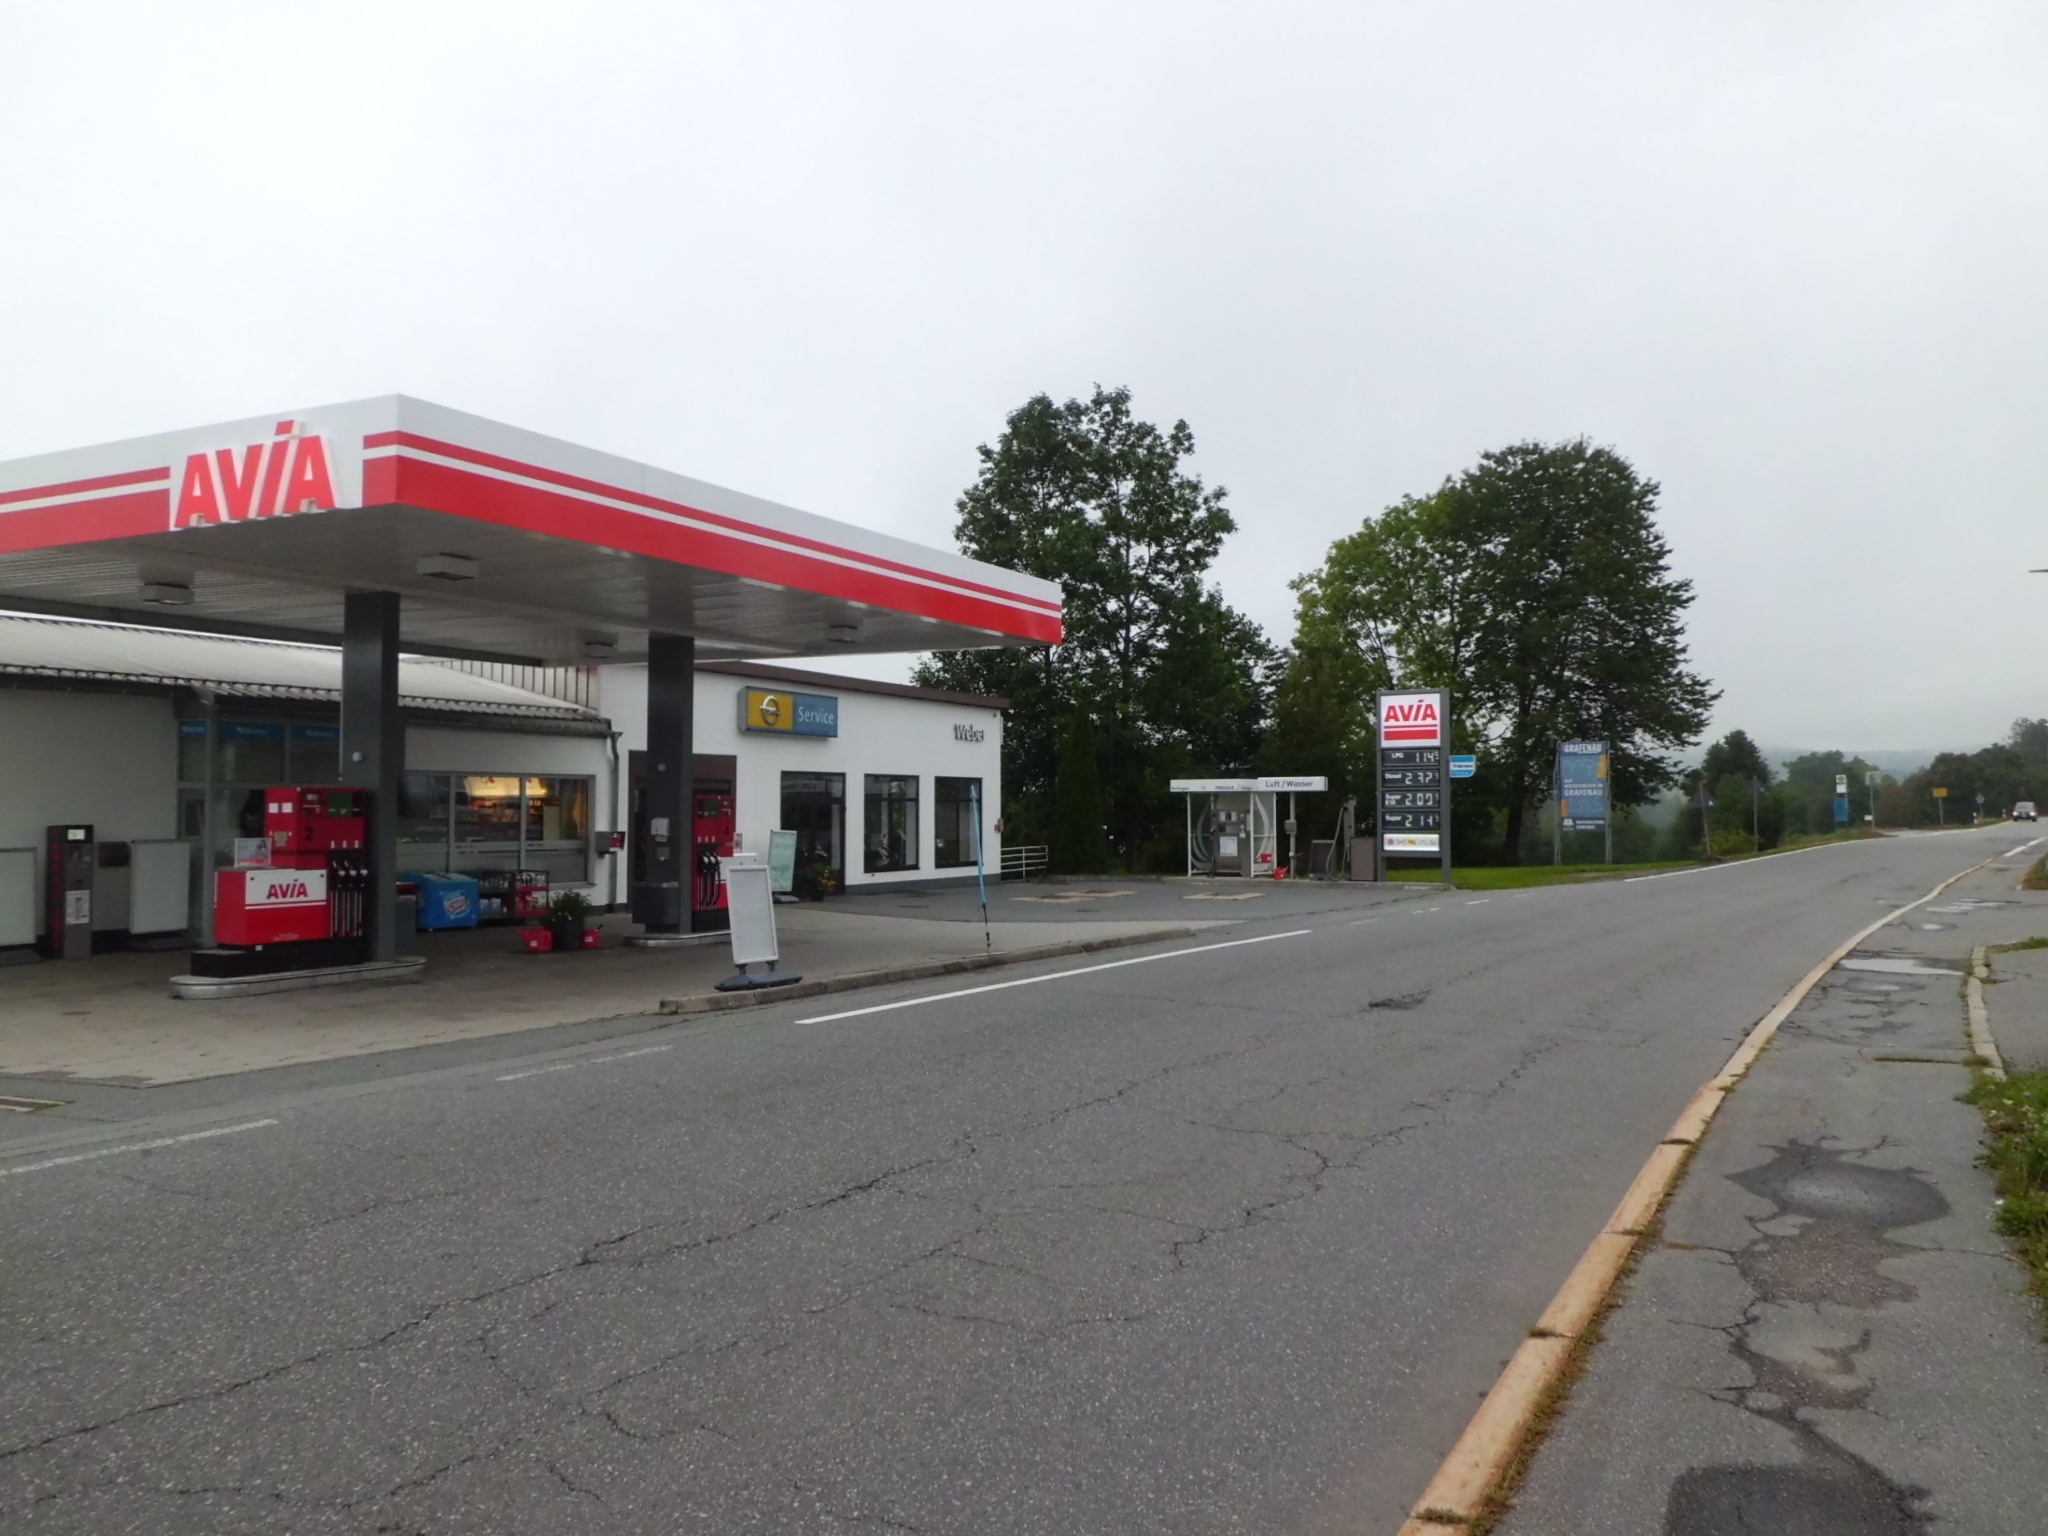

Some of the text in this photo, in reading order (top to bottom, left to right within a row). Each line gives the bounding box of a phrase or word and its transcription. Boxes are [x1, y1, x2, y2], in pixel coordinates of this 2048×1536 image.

[174, 420, 337, 528] AVIA
[798, 706, 834, 725] Service
[1384, 699, 1438, 722] AVIA
[953, 723, 984, 742] Weber
[1564, 743, 1602, 753] GRAFENAU
[1265, 780, 1280, 788] Luft
[1286, 780, 1314, 788] Wasser
[1564, 789, 1603, 797] GRAFENAU
[1385, 814, 1402, 822] Super
[305, 826, 313, 841] 2
[266, 879, 309, 900] AVIA
